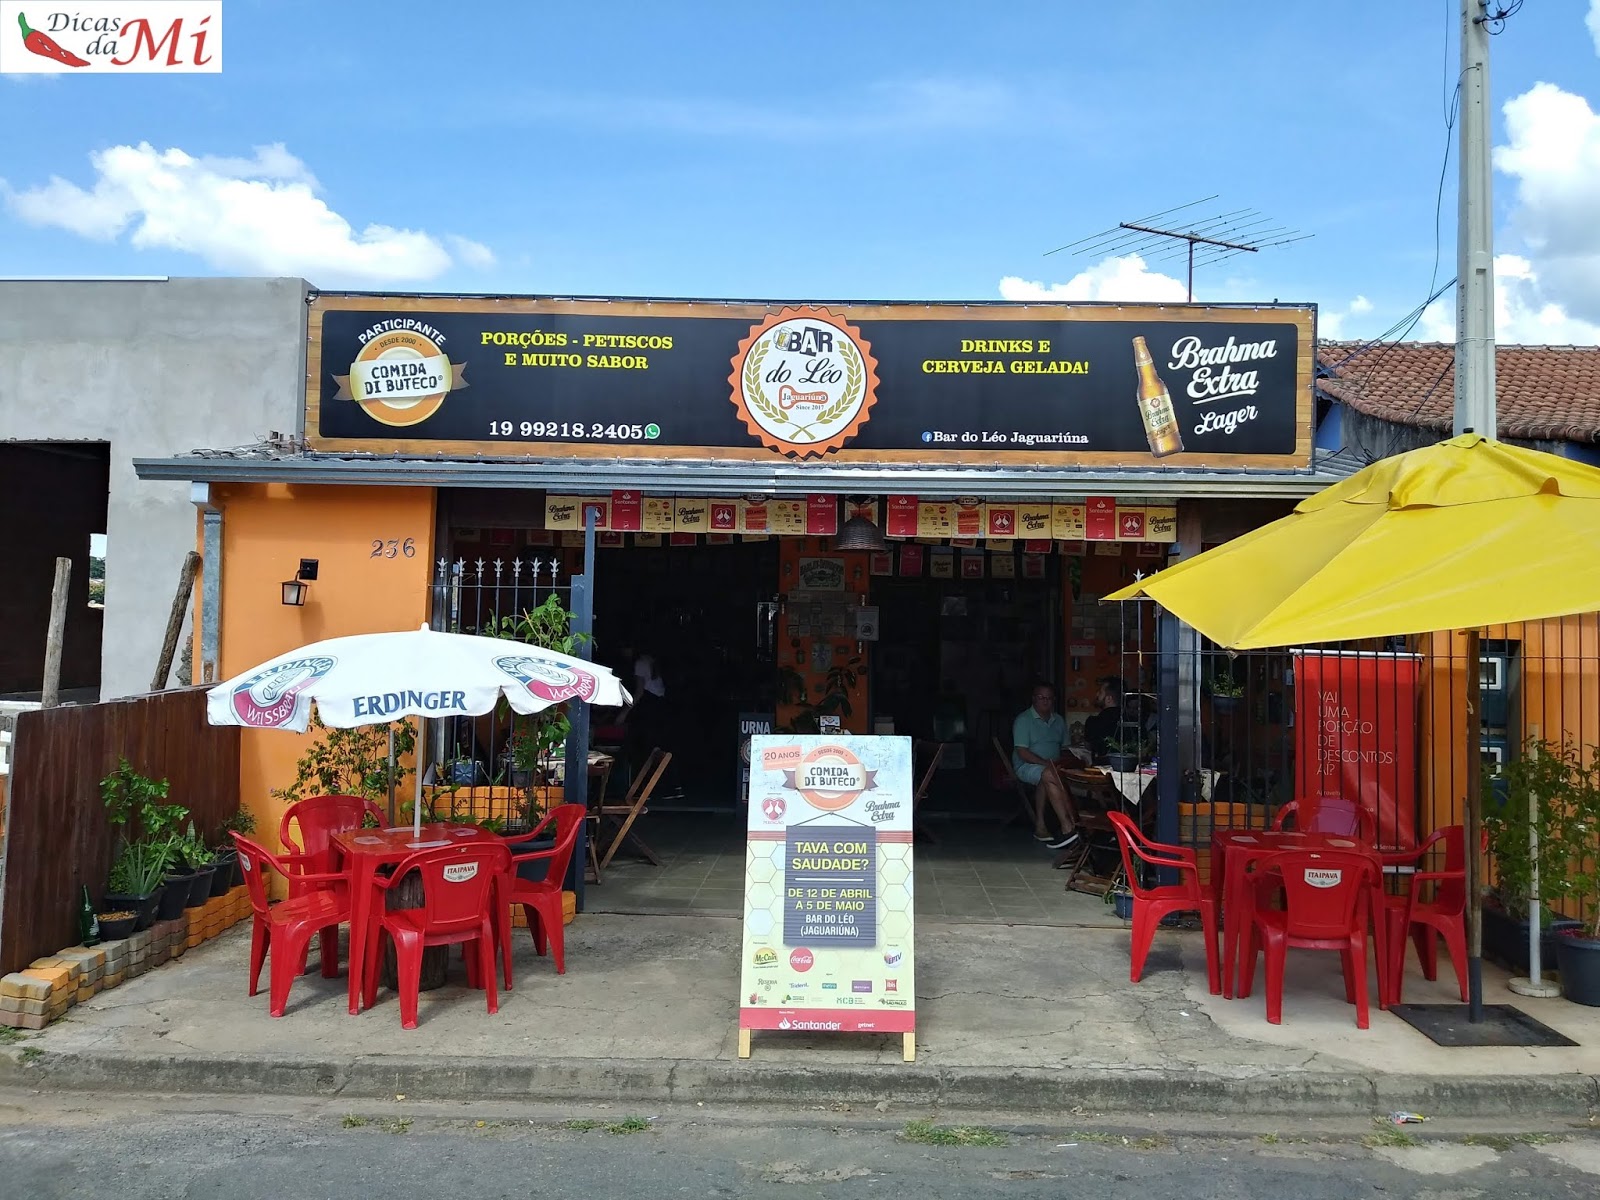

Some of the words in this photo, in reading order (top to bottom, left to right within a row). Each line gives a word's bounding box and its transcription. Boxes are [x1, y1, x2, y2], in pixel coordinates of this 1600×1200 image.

[358, 319, 446, 346] PARTICIPANTE
[481, 329, 567, 349] PORÇÕES
[583, 334, 673, 350] PETISCOS
[380, 337, 400, 348] DESDE
[401, 337, 416, 345] 2000
[788, 326, 833, 357] BAR
[960, 339, 1033, 353] DRINKS
[1037, 340, 1051, 354] E
[1168, 335, 1277, 371] Brahma
[504, 353, 517, 366] E
[522, 354, 582, 368] MUITO
[586, 355, 648, 369] SABOR
[922, 360, 1005, 374] CERVEJA
[1010, 360, 1090, 375] GELADA!
[371, 362, 427, 379] COMIDA
[765, 360, 792, 383] do
[798, 358, 843, 384] Léo
[364, 380, 381, 395] DI
[1186, 365, 1259, 399] Extra
[1194, 404, 1258, 436] Lager
[489, 421, 513, 437] 19
[520, 422, 643, 439] 99218.2405
[933, 431, 958, 443] Bar
[962, 431, 978, 443] do
[981, 430, 1007, 443] Léo
[1010, 431, 1089, 445] Jaguariúna
[370, 538, 415, 558] 236
[353, 690, 467, 718] ERDINGER
[1318, 691, 1338, 703] VAI
[1318, 706, 1350, 718] UMA
[741, 721, 771, 734] URNA
[1318, 719, 1373, 736] PORÇÃO
[1318, 735, 1336, 747] DE
[764, 752, 777, 760] 20
[778, 751, 800, 760] ANOS
[1318, 749, 1393, 764] DESCONTOS
[810, 766, 849, 777] COMIDA
[804, 777, 816, 786] DI
[864, 800, 901, 812] Brahma
[870, 810, 896, 822] Extra
[795, 842, 829, 854] TAVA
[833, 842, 867, 854] COM
[447, 865, 475, 874] ITAIPAVA
[792, 858, 869, 871] SAUDADE?
[788, 888, 804, 898] DE
[806, 888, 818, 898] 12
[821, 889, 836, 898] DE
[840, 889, 873, 899] ABRIL
[795, 901, 804, 910] A
[806, 901, 813, 910] 5
[816, 901, 832, 910] DE
[835, 901, 865, 911] MAIO
[805, 914, 822, 923] BAR
[825, 914, 836, 923] DO
[838, 913, 855, 924] LÉO
[800, 925, 859, 937] (JAGUARIÚNA)
[792, 1020, 841, 1030] Santander
